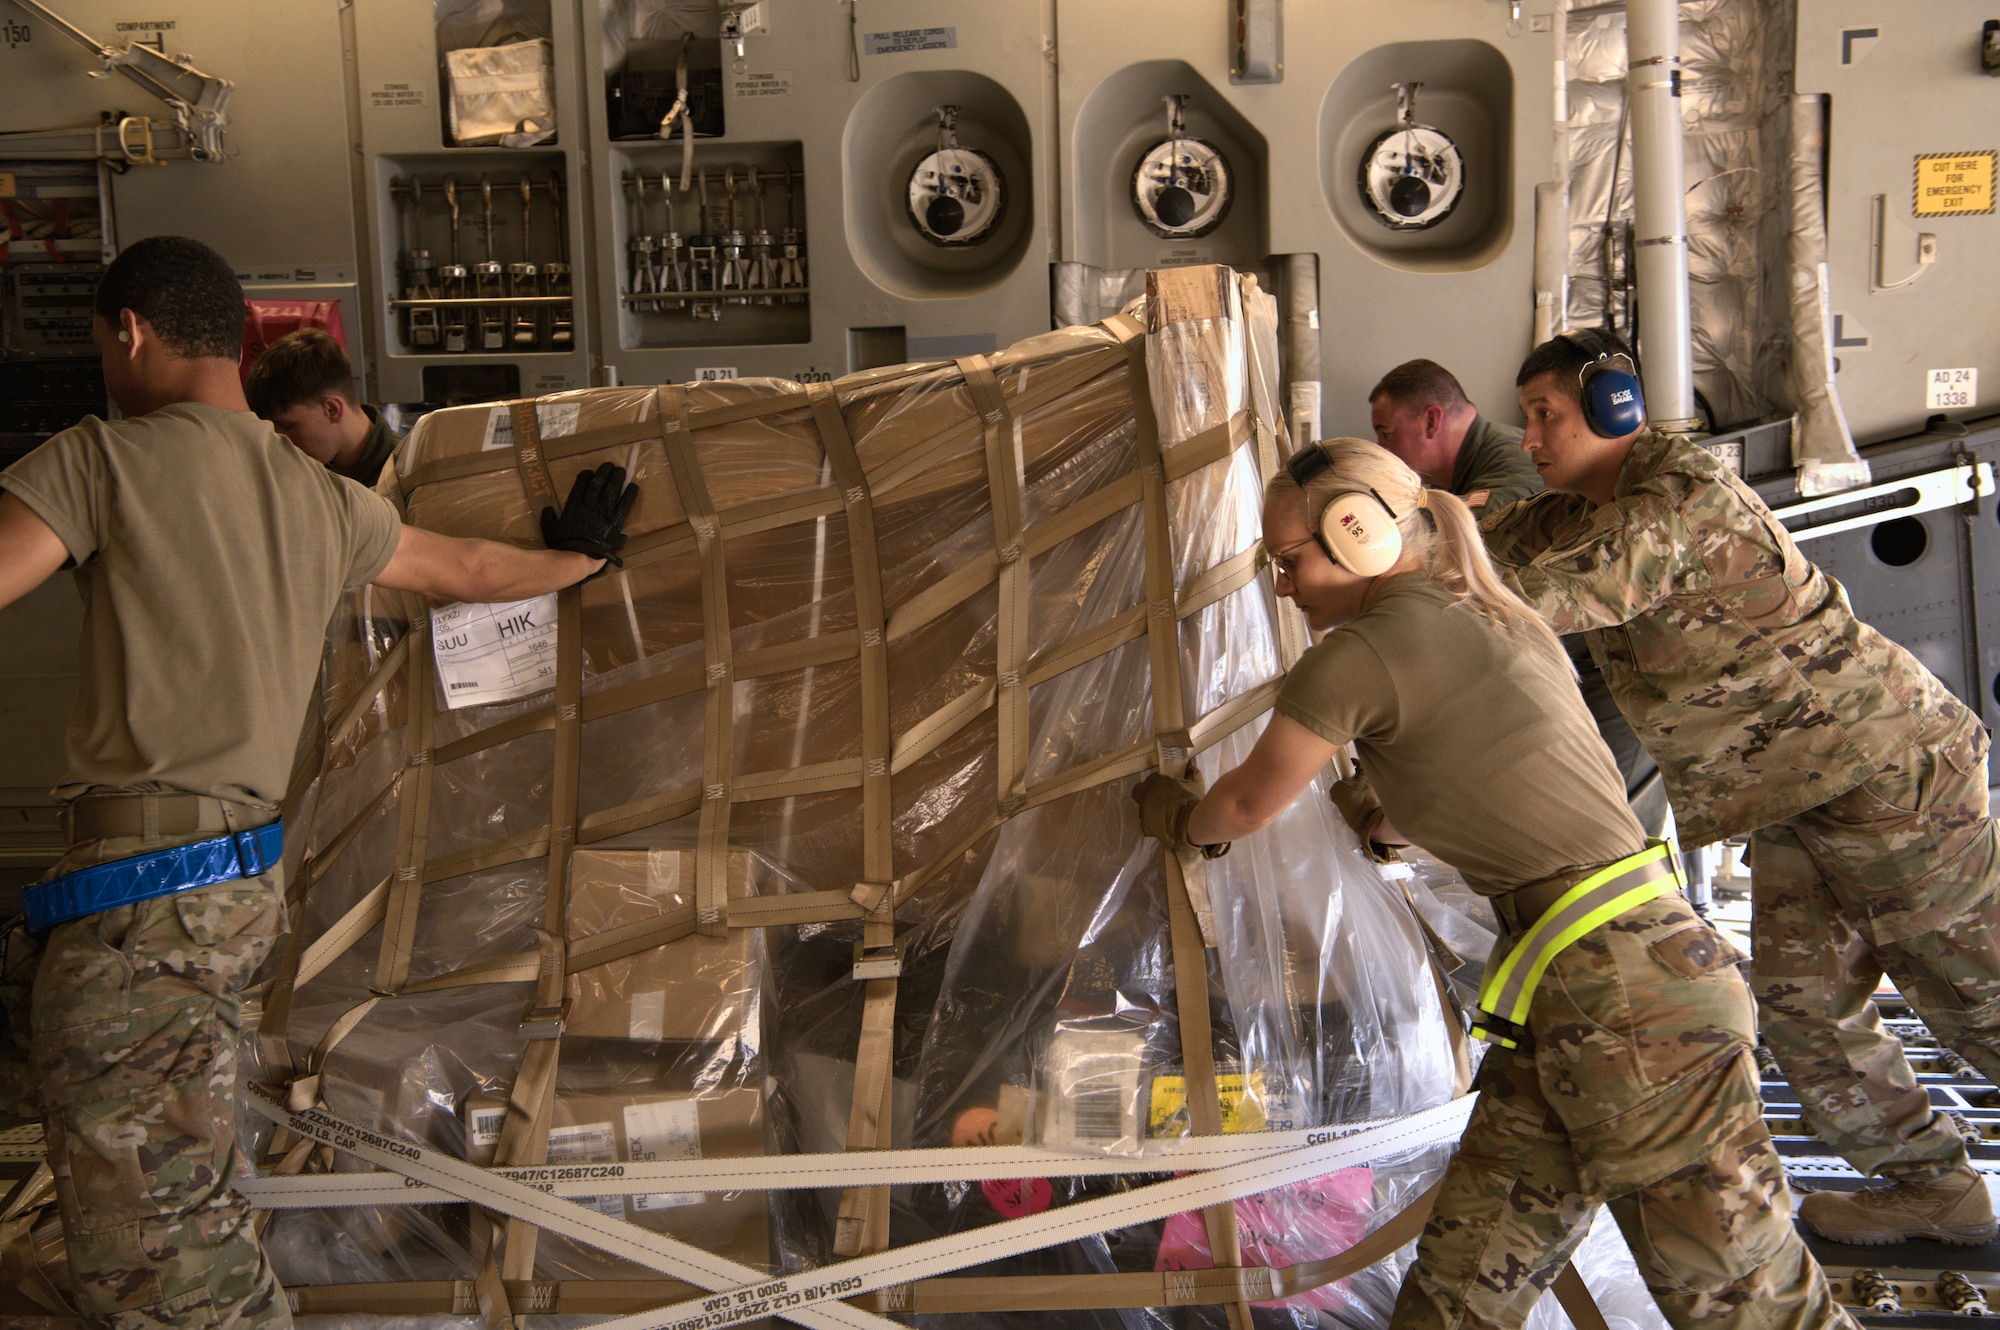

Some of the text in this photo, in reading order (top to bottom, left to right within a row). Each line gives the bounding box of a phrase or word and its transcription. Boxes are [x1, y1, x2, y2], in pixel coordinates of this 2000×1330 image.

[1932, 160, 1979, 172] CUT HERE
[1945, 173, 1964, 183] FOR
[1926, 184, 1982, 196] EMERGENCY
[1943, 197, 1964, 207] EXIT
[702, 369, 716, 381] AD
[1934, 370, 1970, 383] AD 24
[1935, 391, 1967, 406] 1338
[1726, 445, 1741, 458] 23
[1339, 511, 1356, 527] 3M
[1351, 525, 1364, 538] 95
[497, 611, 536, 638] HIK
[436, 632, 468, 651] SUU
[527, 640, 548, 653] 1646
[536, 665, 553, 678] 341
[288, 1117, 358, 1152] 5000 LB. CAP.
[498, 1165, 625, 1182] Z947/C12687C240
[804, 1276, 863, 1301] CGU-1/B
[701, 1280, 788, 1312] 5000 LB. CAP.
[773, 1292, 801, 1309] CL2
